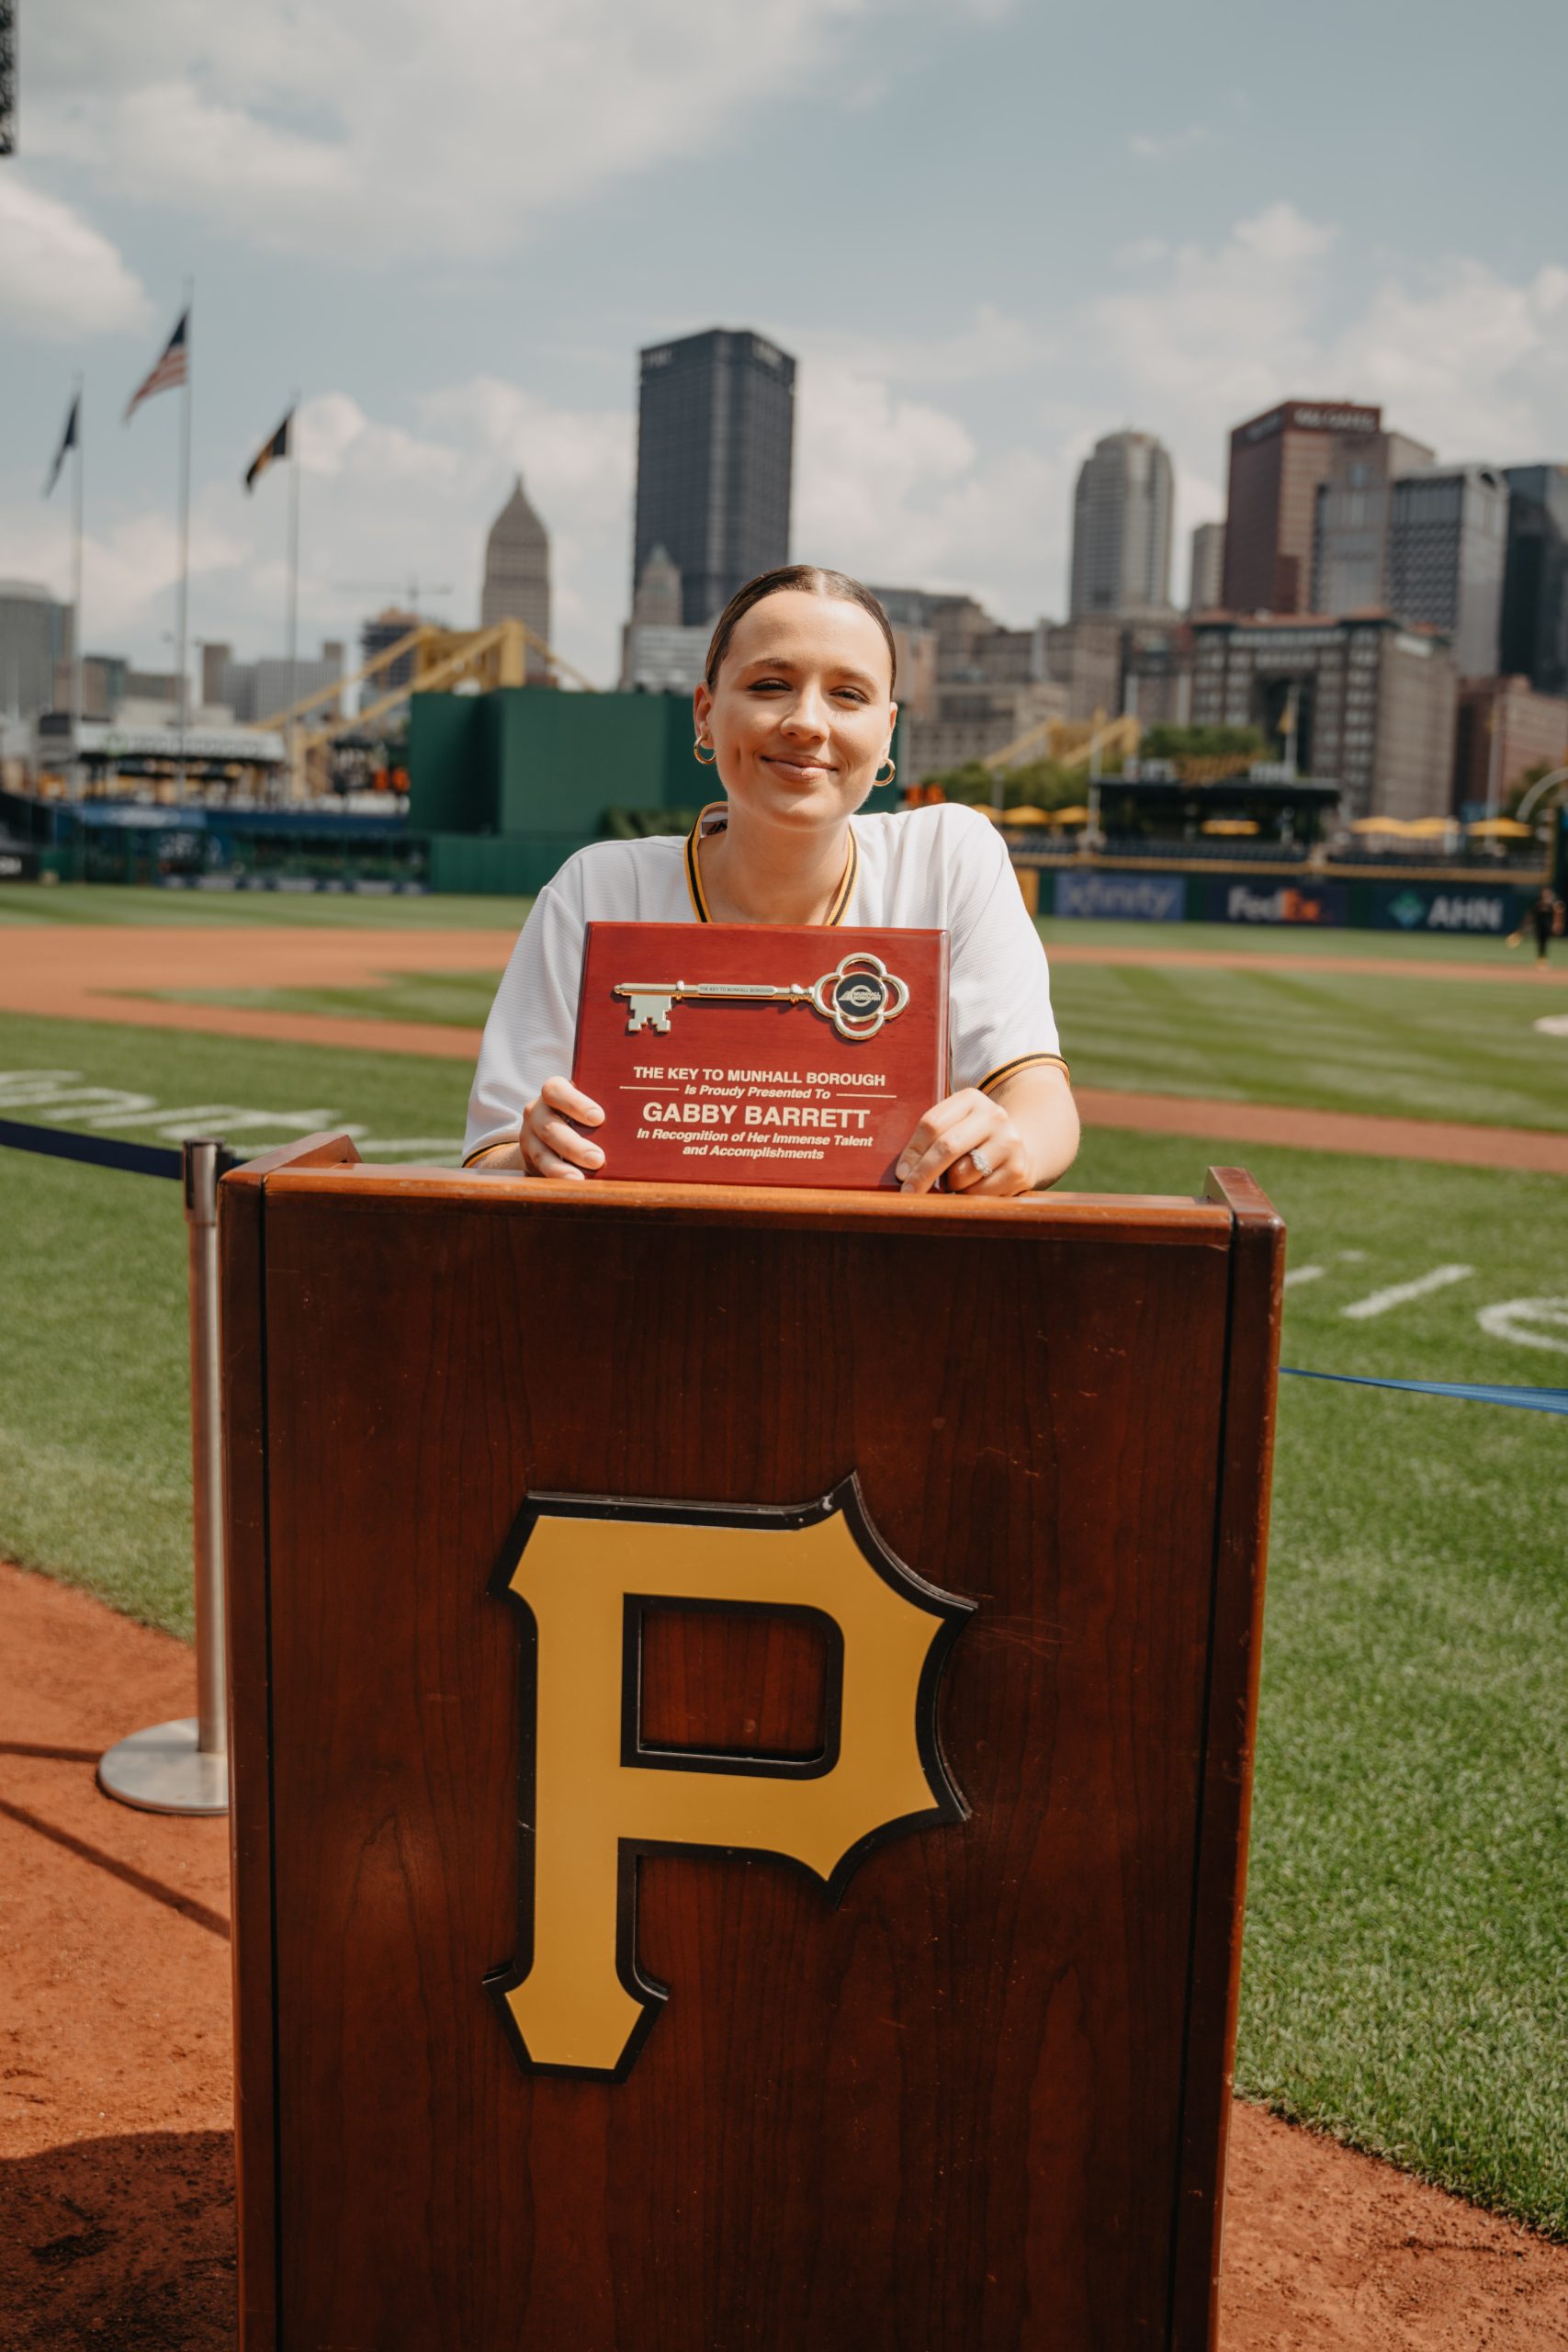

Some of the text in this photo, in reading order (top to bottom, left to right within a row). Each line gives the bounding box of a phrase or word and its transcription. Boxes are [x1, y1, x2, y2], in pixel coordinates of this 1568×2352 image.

[1227, 886, 1321, 922] FedEx
[1427, 897, 1502, 930] AHN
[634, 1067, 885, 1086] THE KEY TO MUNHALL BOROUGH
[684, 1085, 830, 1099] Is Proudy Presented To
[643, 1102, 870, 1128] GABBY BARRETT
[637, 1128, 874, 1147] In Recognition of Her Immense Talent
[682, 1145, 825, 1159] and Accomplishments
[482, 1472, 979, 2082] P
